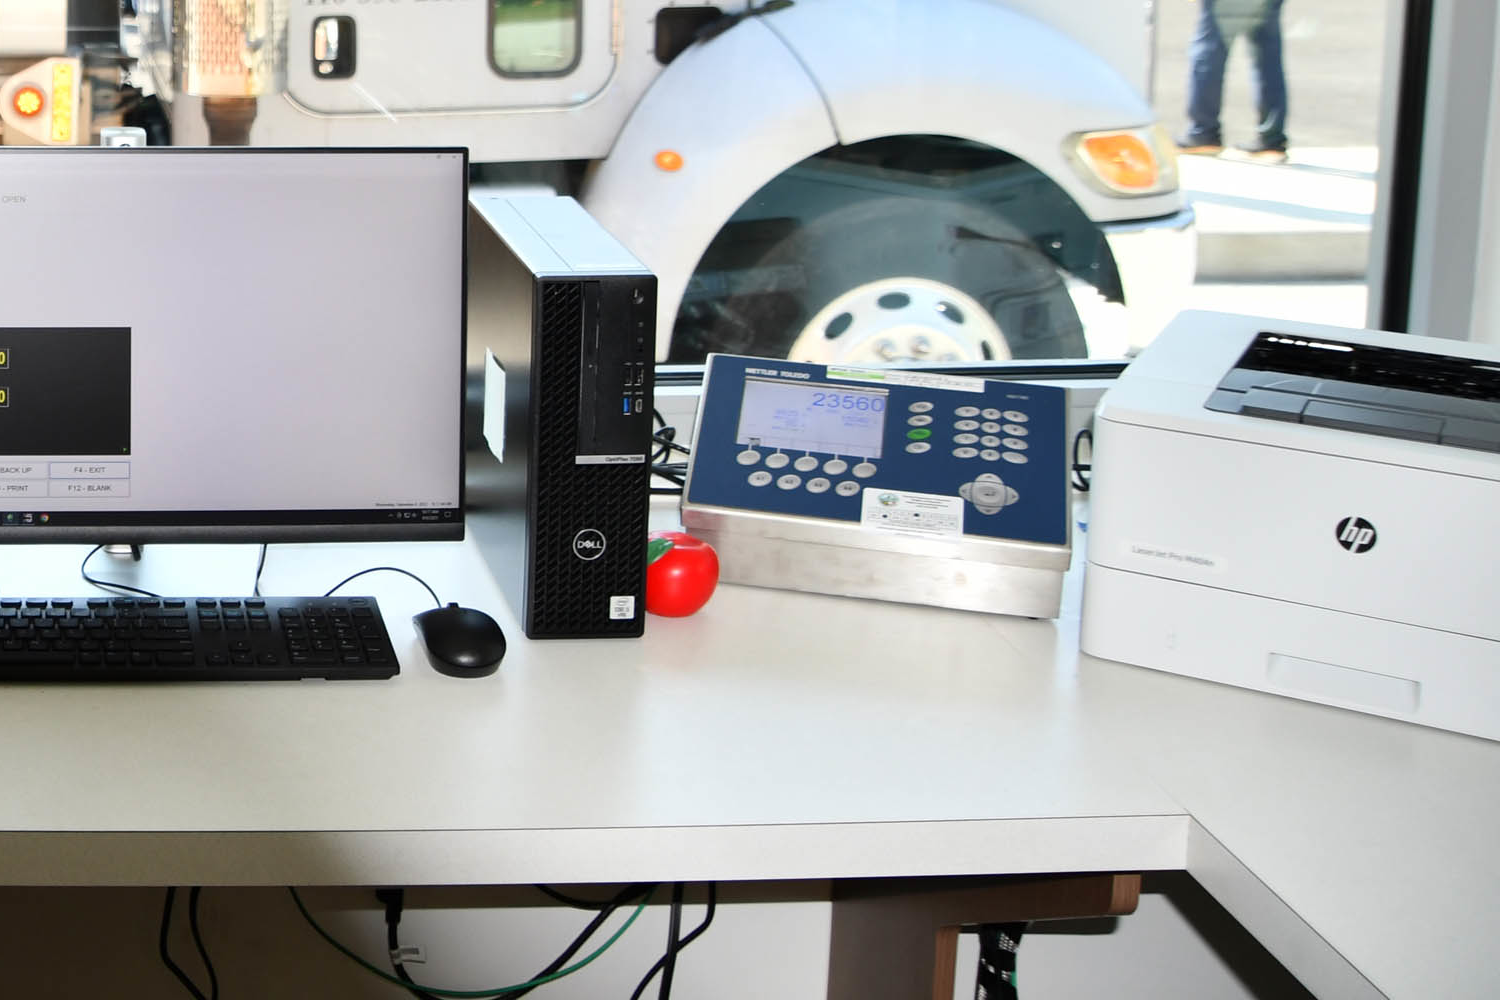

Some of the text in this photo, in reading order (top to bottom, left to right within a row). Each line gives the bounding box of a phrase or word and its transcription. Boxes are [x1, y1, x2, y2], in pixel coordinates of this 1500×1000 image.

[811, 392, 885, 413] 23560
[577, 540, 603, 549] DELL
[1339, 516, 1374, 553] hp
